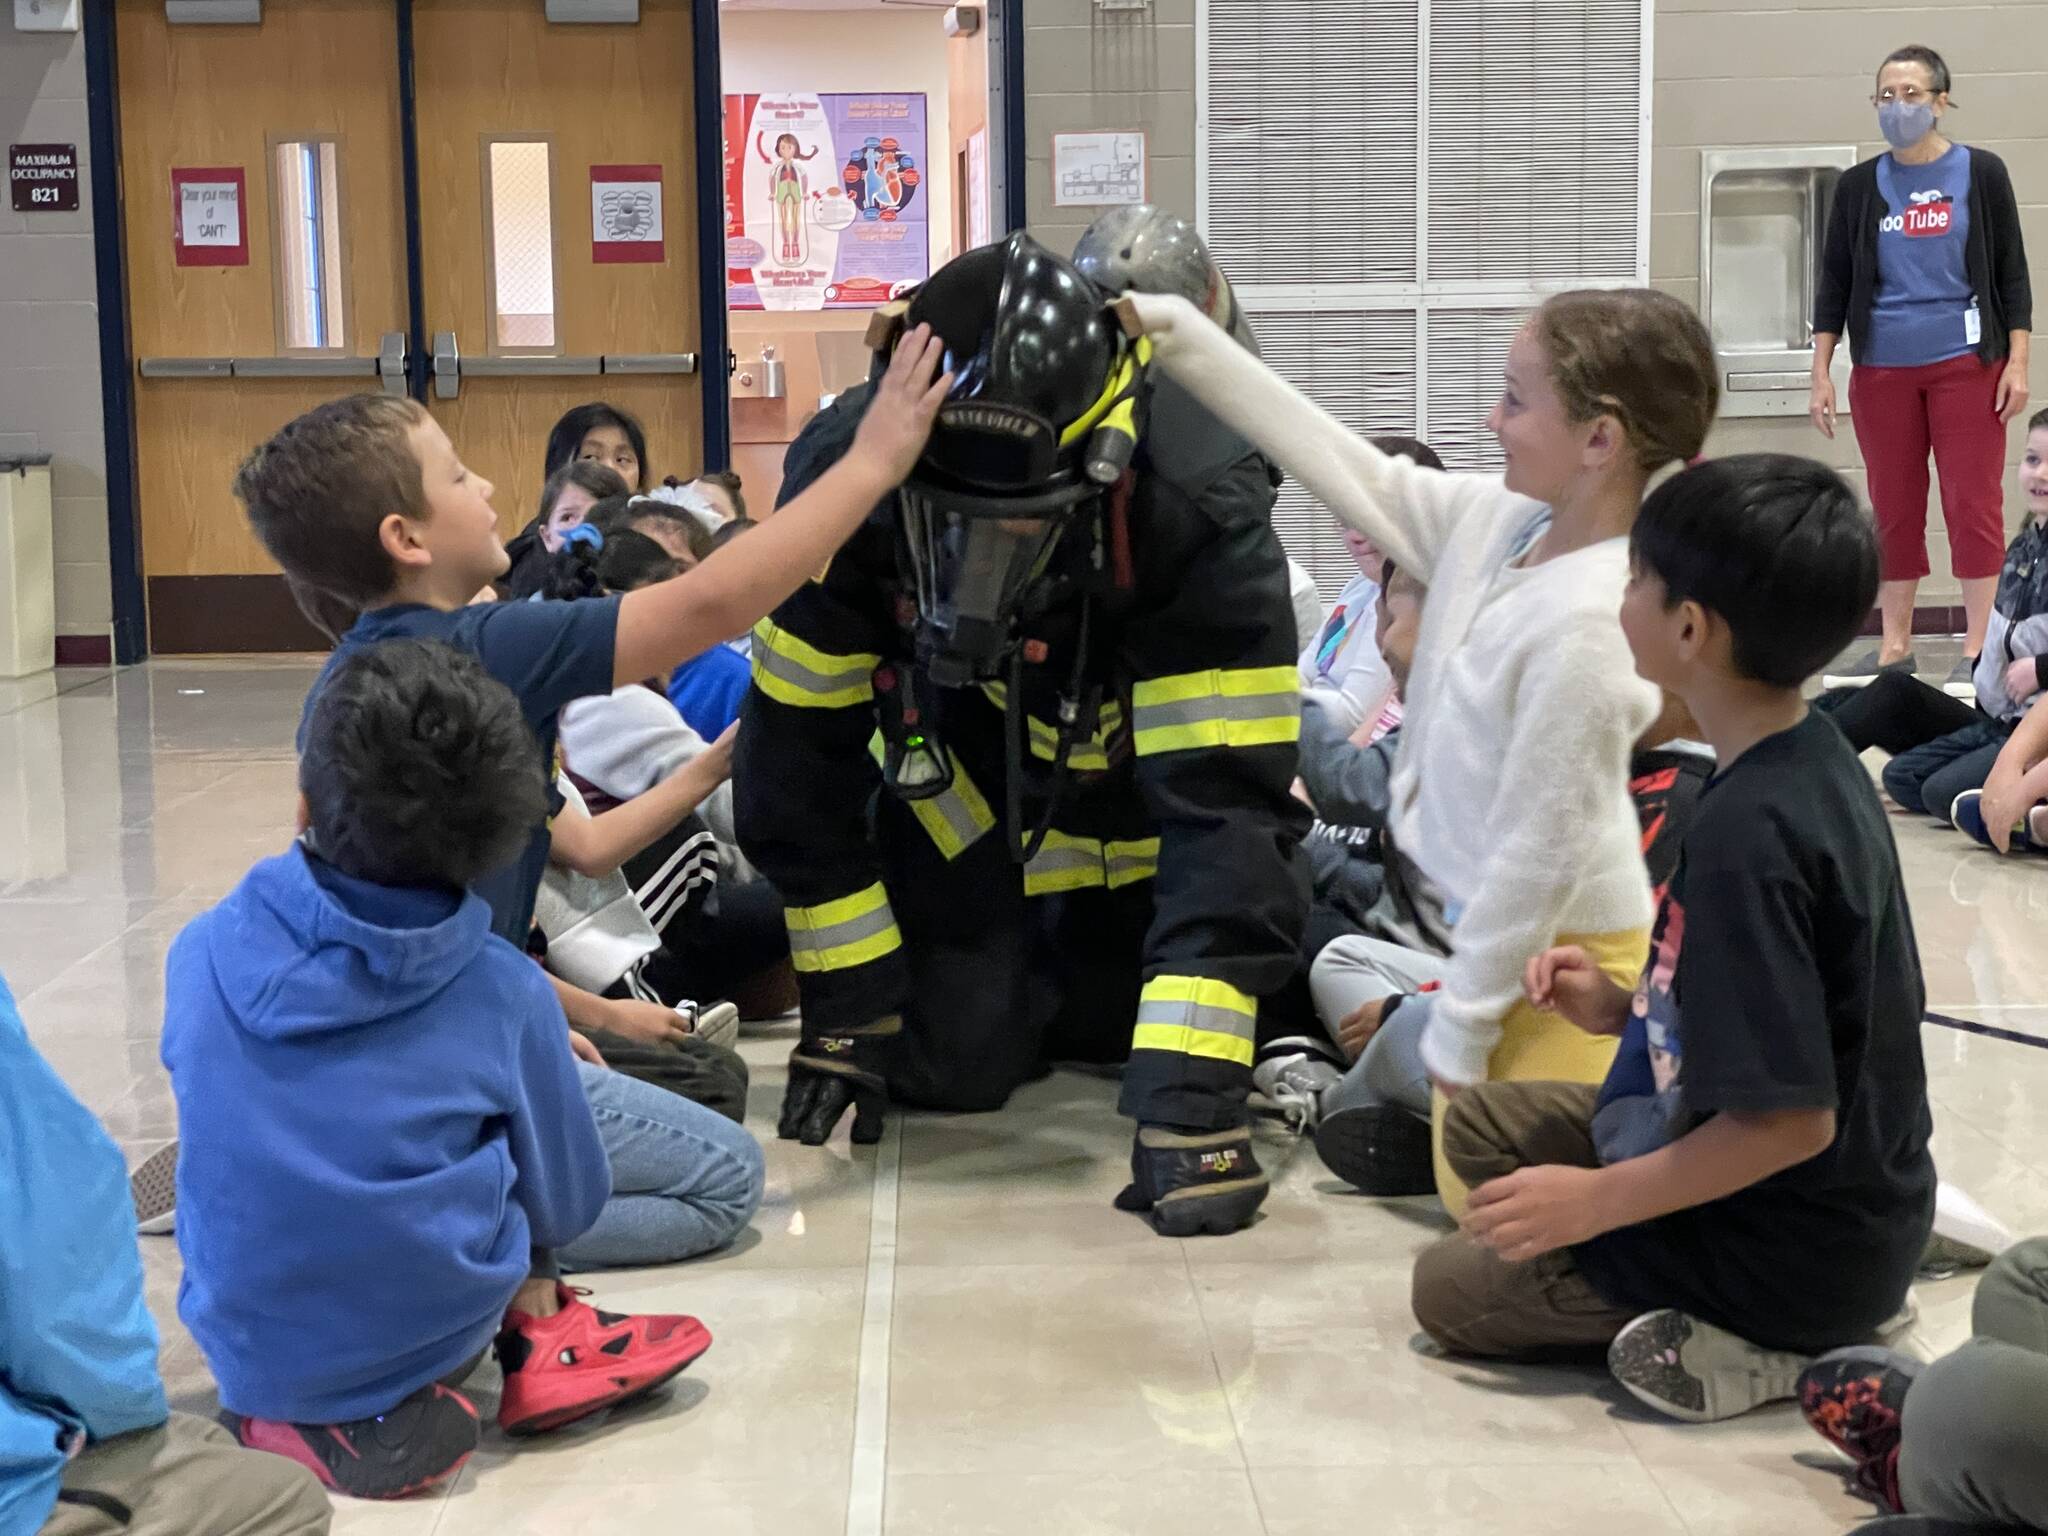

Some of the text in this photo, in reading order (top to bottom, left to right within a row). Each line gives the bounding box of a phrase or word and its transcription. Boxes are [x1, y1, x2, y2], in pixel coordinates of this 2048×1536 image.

[15, 154, 71, 166] MAXIMUM
[11, 168, 76, 179] OCCUPANCY
[31, 187, 59, 202] 821
[202, 190, 217, 203] your
[1907, 208, 1948, 230] Tube
